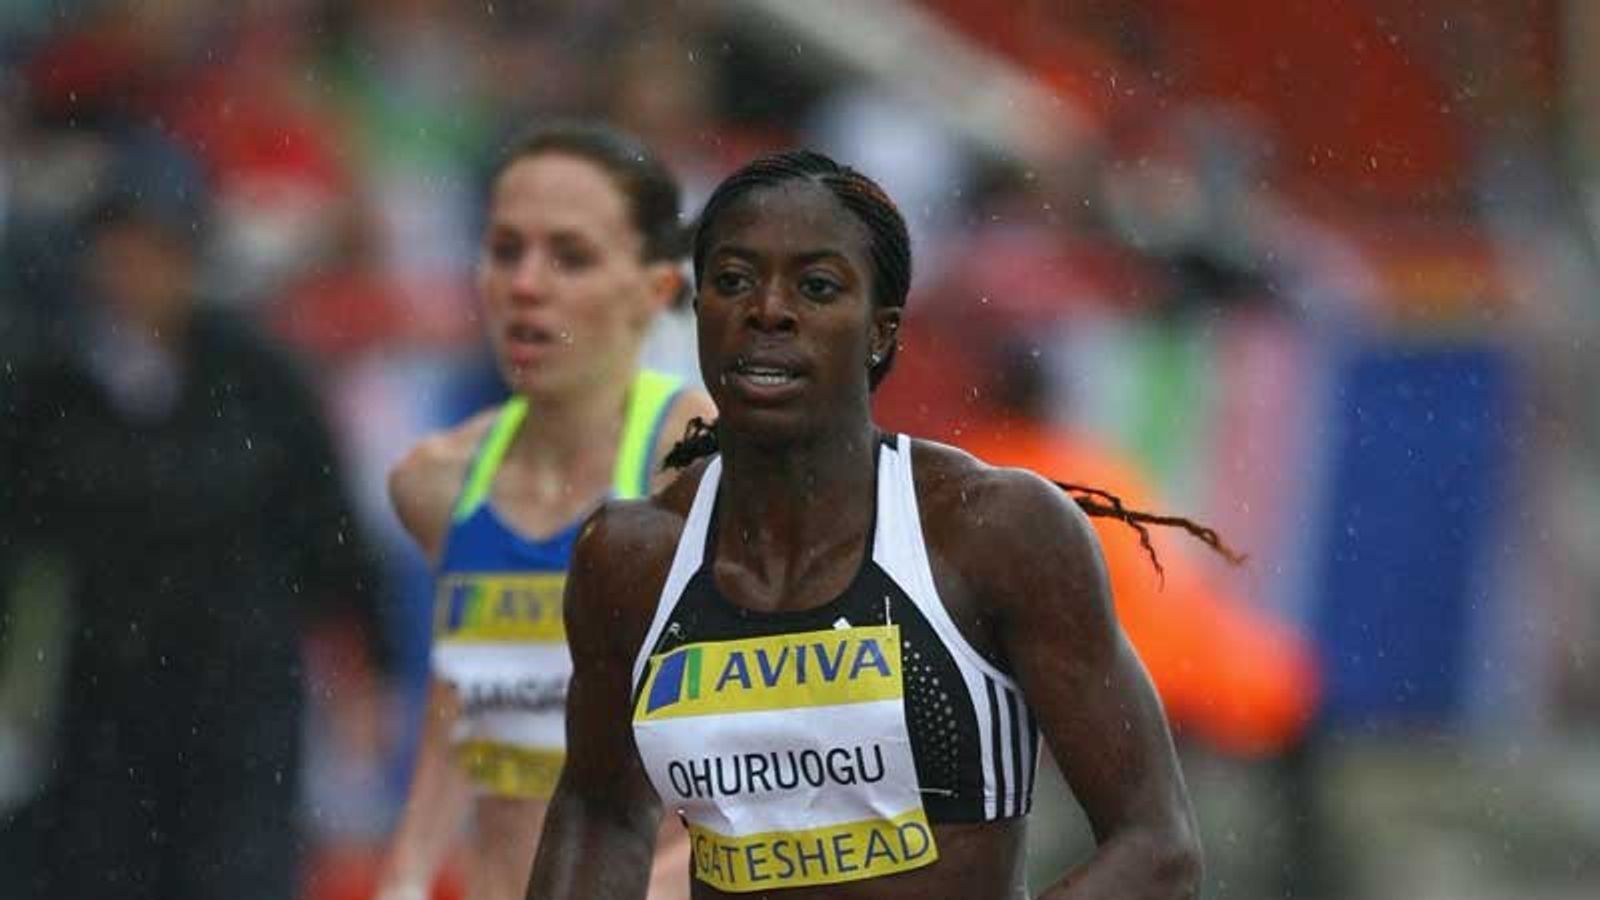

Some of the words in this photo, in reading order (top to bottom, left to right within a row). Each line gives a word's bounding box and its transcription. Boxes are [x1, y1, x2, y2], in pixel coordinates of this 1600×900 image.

[715, 638, 891, 692] AVIVA
[667, 744, 885, 799] OHURUOGU
[696, 821, 930, 883] GATESHEAD
